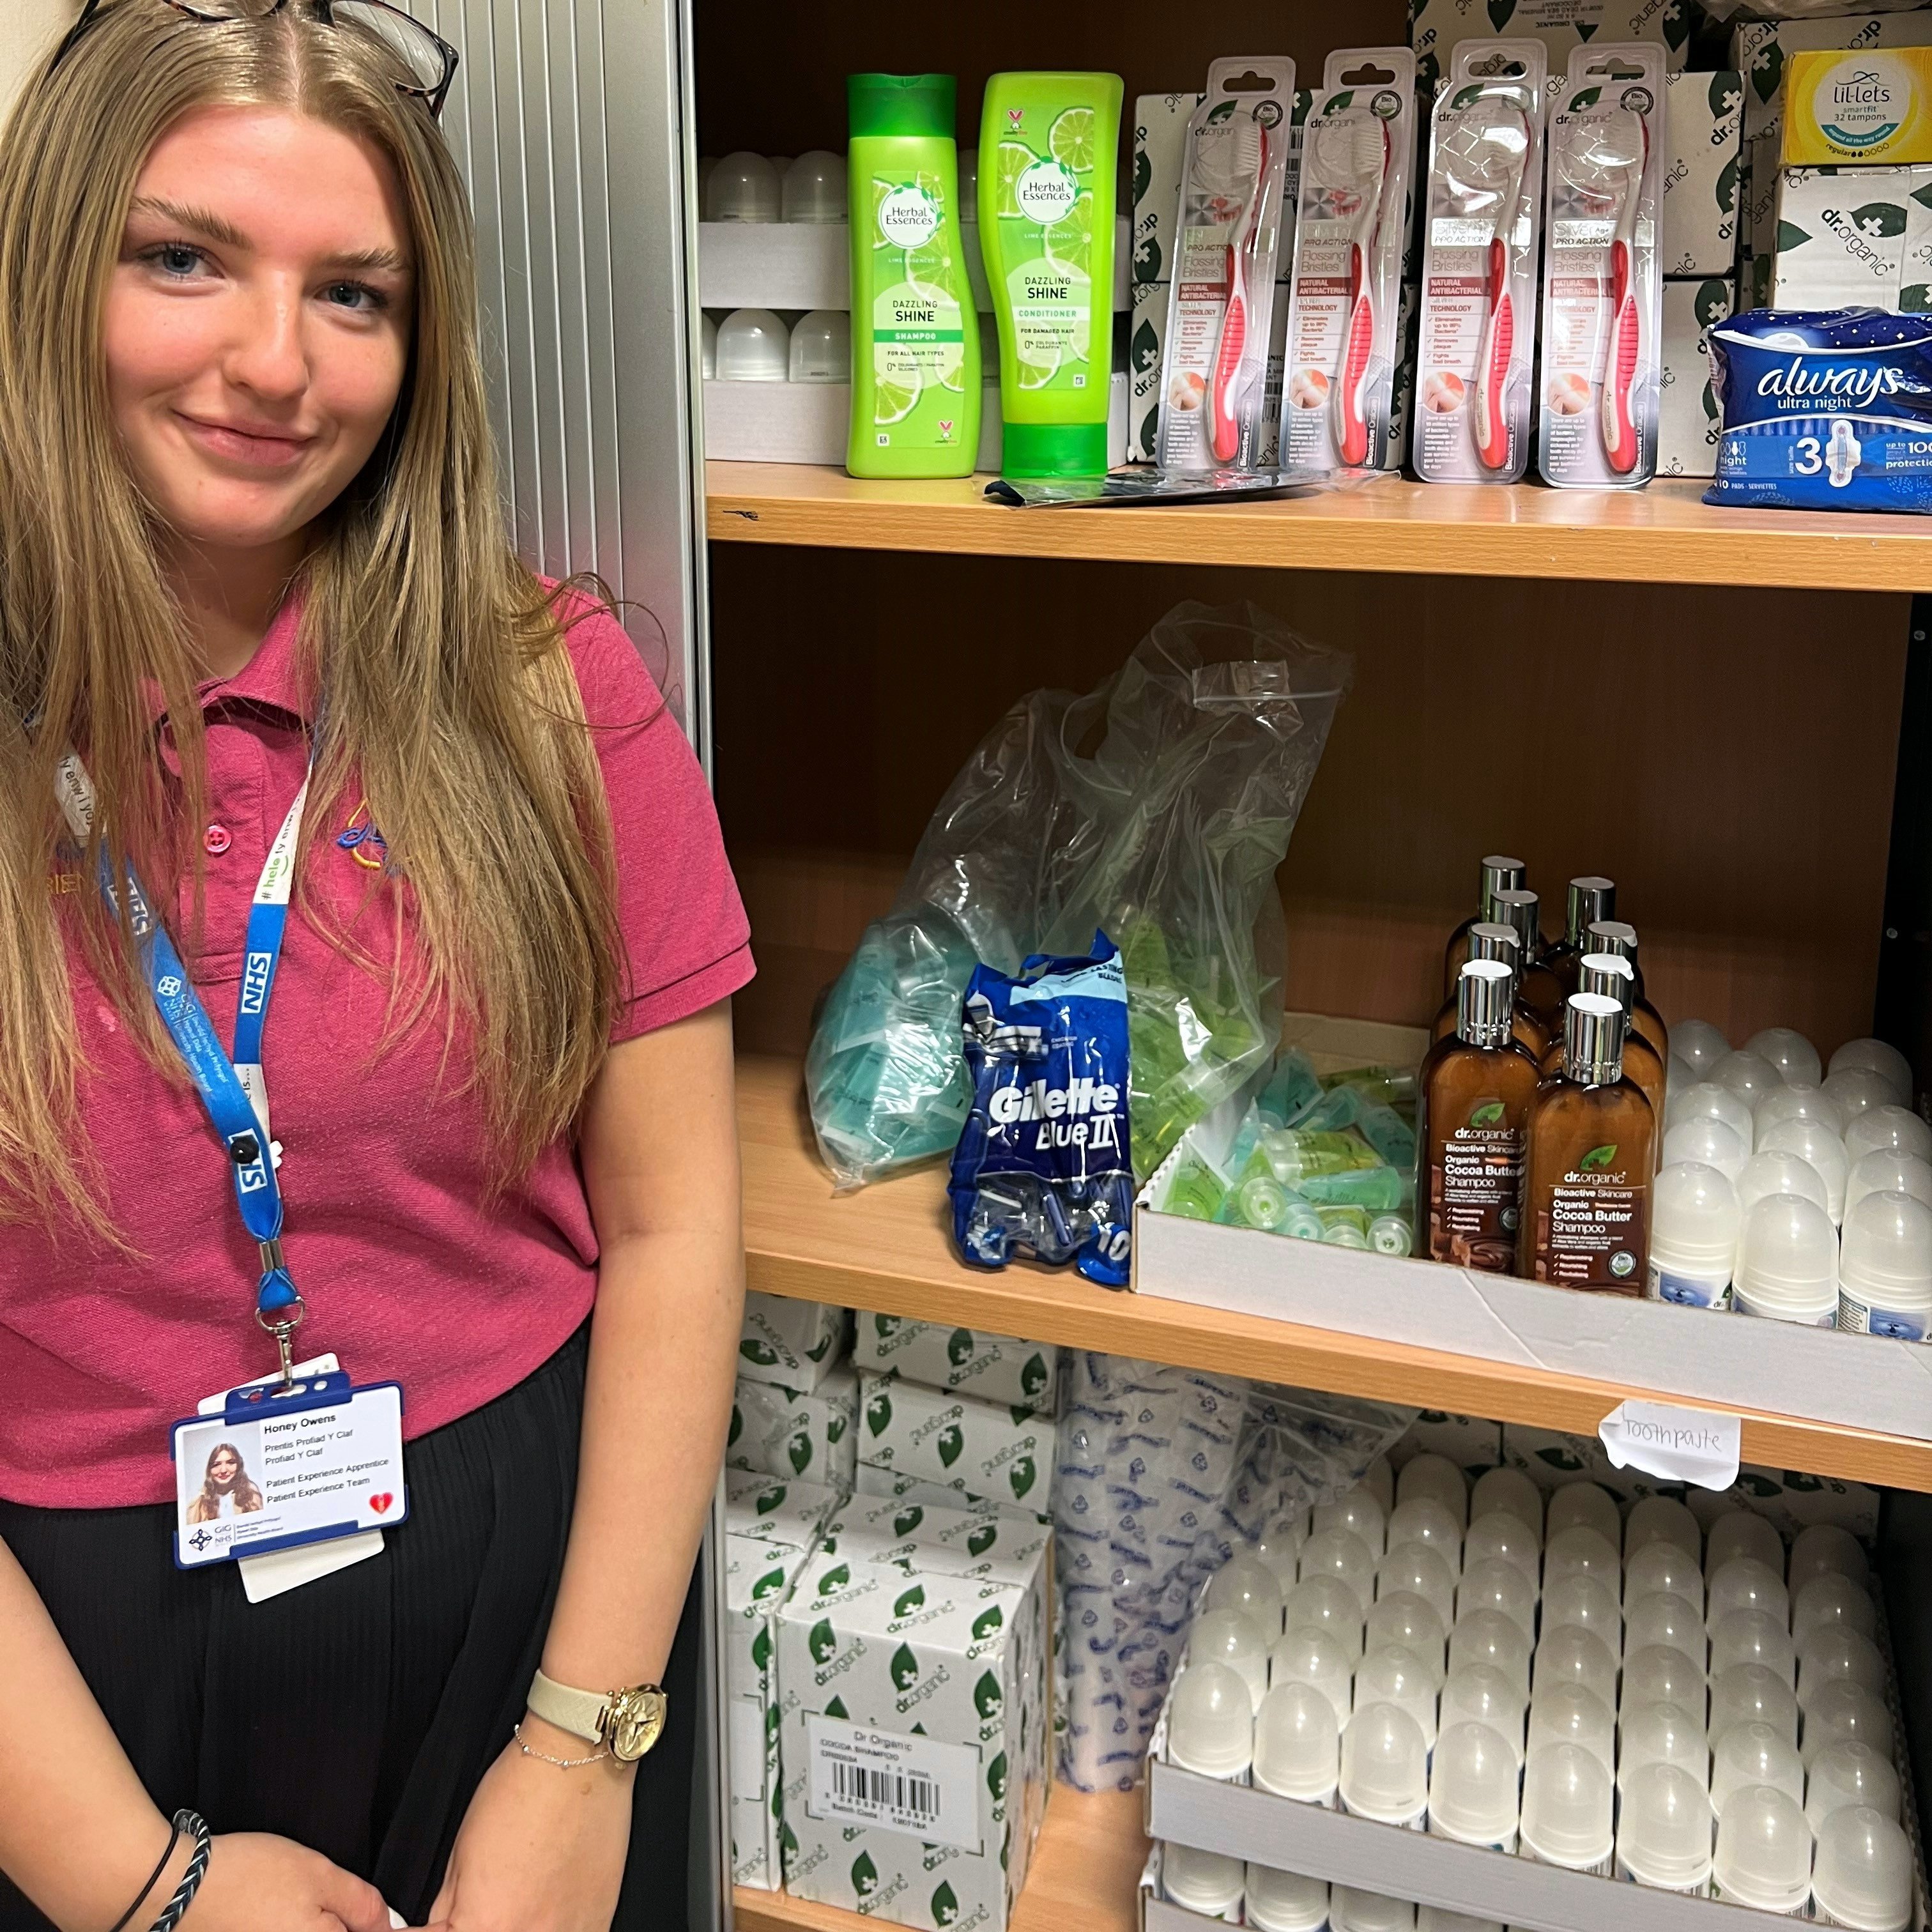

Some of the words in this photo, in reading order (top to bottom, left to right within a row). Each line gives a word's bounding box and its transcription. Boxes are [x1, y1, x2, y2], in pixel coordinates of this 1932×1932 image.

[1825, 144, 1851, 156] regular
[1029, 182, 1065, 192] Herbal
[1023, 190, 1070, 200] Essences
[892, 207, 928, 217] Herbal
[886, 215, 933, 225] Essences
[1821, 208, 1896, 276] dr.organic
[1302, 250, 1346, 263] Flossing
[1432, 249, 1478, 262] Flossing
[1554, 250, 1602, 263] Flossing
[1183, 266, 1219, 278] Bristles
[1301, 261, 1339, 272] Bristles
[1432, 260, 1472, 272] Bristles
[1554, 261, 1595, 272] Bristles
[1025, 277, 1071, 285] DAZZLING
[1028, 288, 1068, 299] SHINE
[896, 310, 935, 321] SHINE
[1757, 356, 1903, 408] always
[1777, 396, 1809, 409] ultra
[1815, 395, 1852, 411] night
[1366, 429, 1376, 465] Bioactive
[1505, 433, 1514, 470] Bioactive
[1720, 456, 1747, 466] night
[1795, 437, 1822, 475] 3
[243, 954, 270, 1011] NHS
[990, 1078, 1119, 1123] Gillette
[1036, 1121, 1090, 1151] Blue
[1455, 1128, 1515, 1141] dr.organic
[1446, 1144, 1486, 1153] Bioactive
[1445, 1154, 1480, 1165] Organic
[1445, 1164, 1483, 1176] Cocoa
[1445, 1175, 1496, 1188] Shampoo
[1564, 1171, 1626, 1186] dr.organic
[1554, 1188, 1596, 1197] Bioactive
[1597, 1189, 1632, 1199] Skincare
[1553, 1199, 1590, 1209] Organic
[1552, 1209, 1593, 1221] Cocoa
[1595, 1210, 1632, 1222] Butter
[1552, 1220, 1606, 1235] Shampoo
[264, 1422, 298, 1434] Honey
[300, 1414, 336, 1427] Owens
[265, 1442, 294, 1452] Prentis
[296, 1435, 326, 1446] Profiad
[336, 1429, 353, 1439] Claf
[265, 1453, 295, 1465] Profiad
[306, 1448, 323, 1457] Claf
[266, 1476, 295, 1488] Patient
[298, 1467, 344, 1482] Experience
[346, 1458, 389, 1472] Apprentice
[267, 1492, 296, 1503] Patient
[298, 1482, 344, 1497] Experience
[347, 1477, 371, 1487] Team
[215, 1535, 232, 1543] NHS
[811, 1579, 878, 1611] dr.organic
[887, 1600, 956, 1634] dr.organic
[815, 1637, 868, 1685] dr.organic
[896, 1665, 951, 1713] dr.organic
[854, 1731, 867, 1741] Dr
[870, 1734, 913, 1752] Organic
